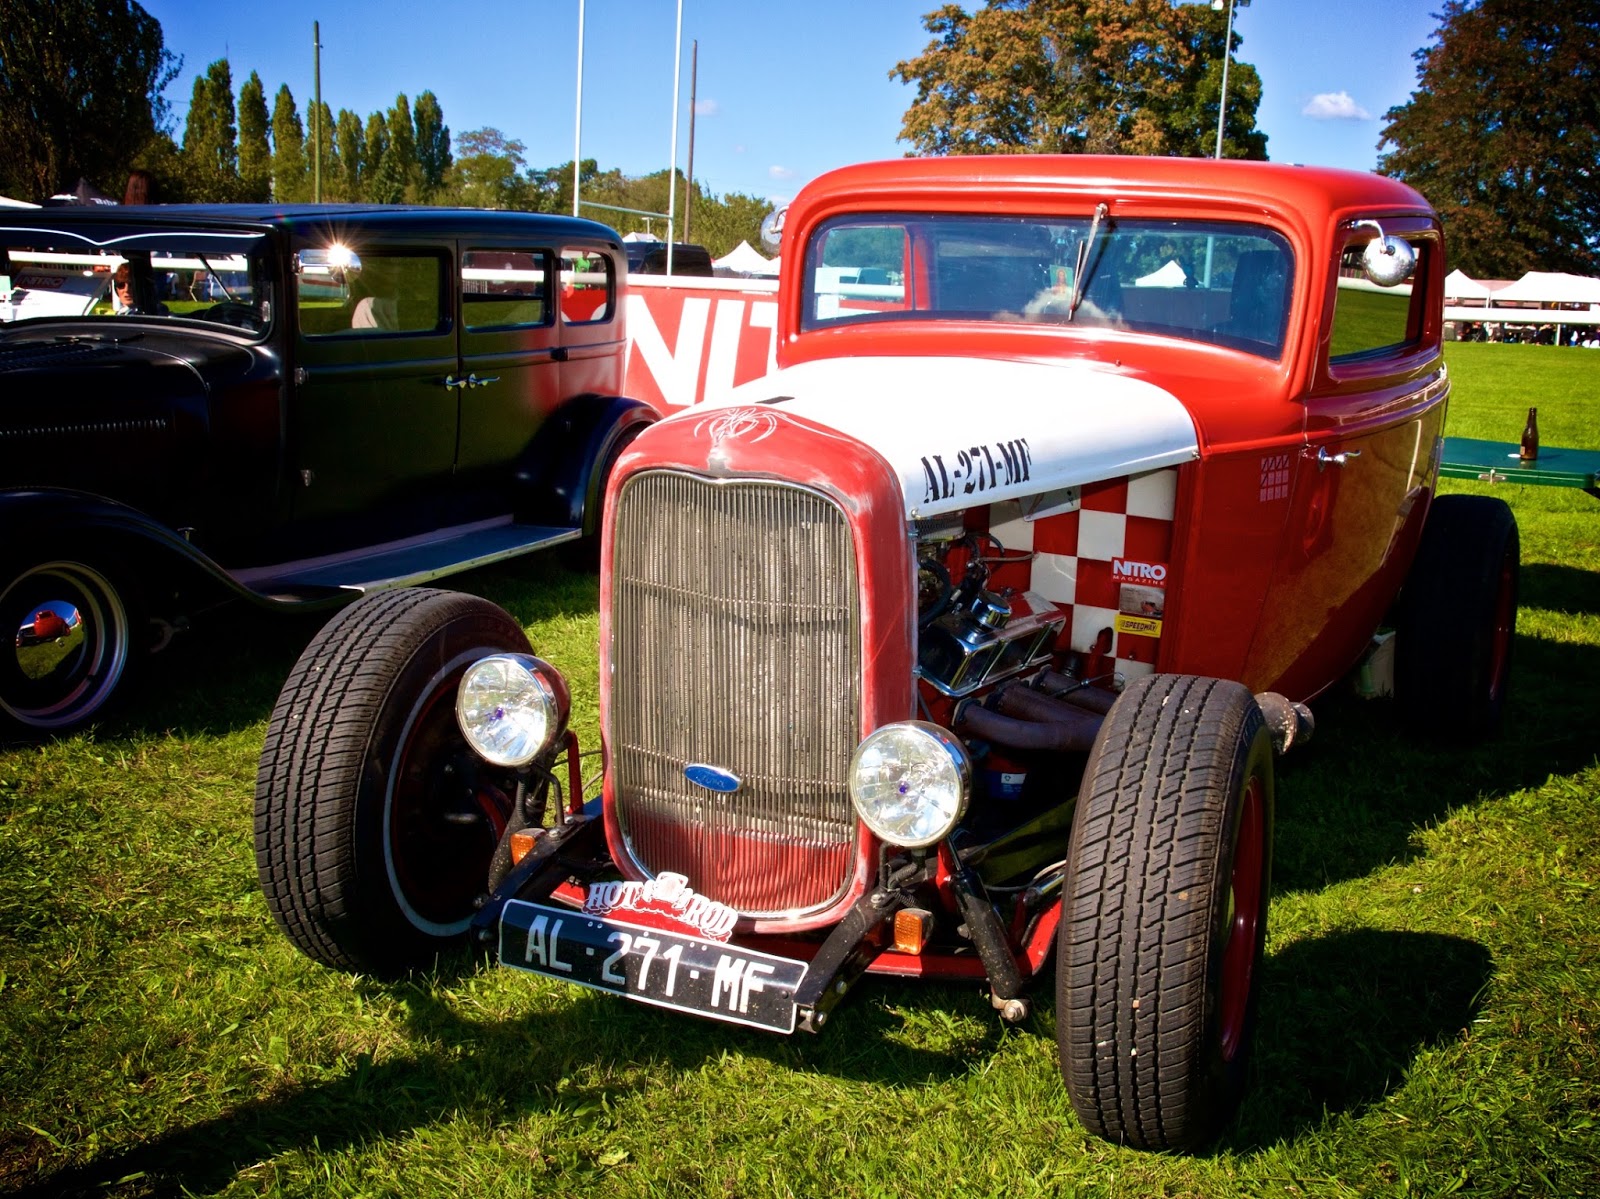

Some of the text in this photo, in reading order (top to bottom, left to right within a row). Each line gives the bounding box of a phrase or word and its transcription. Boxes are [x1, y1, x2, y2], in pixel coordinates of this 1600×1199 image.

[1113, 560, 1166, 580] NITRO
[1113, 575, 1164, 586] MAGAZINE
[1124, 620, 1157, 632] SPEEDWAY
[585, 881, 738, 936] HOT ROD
